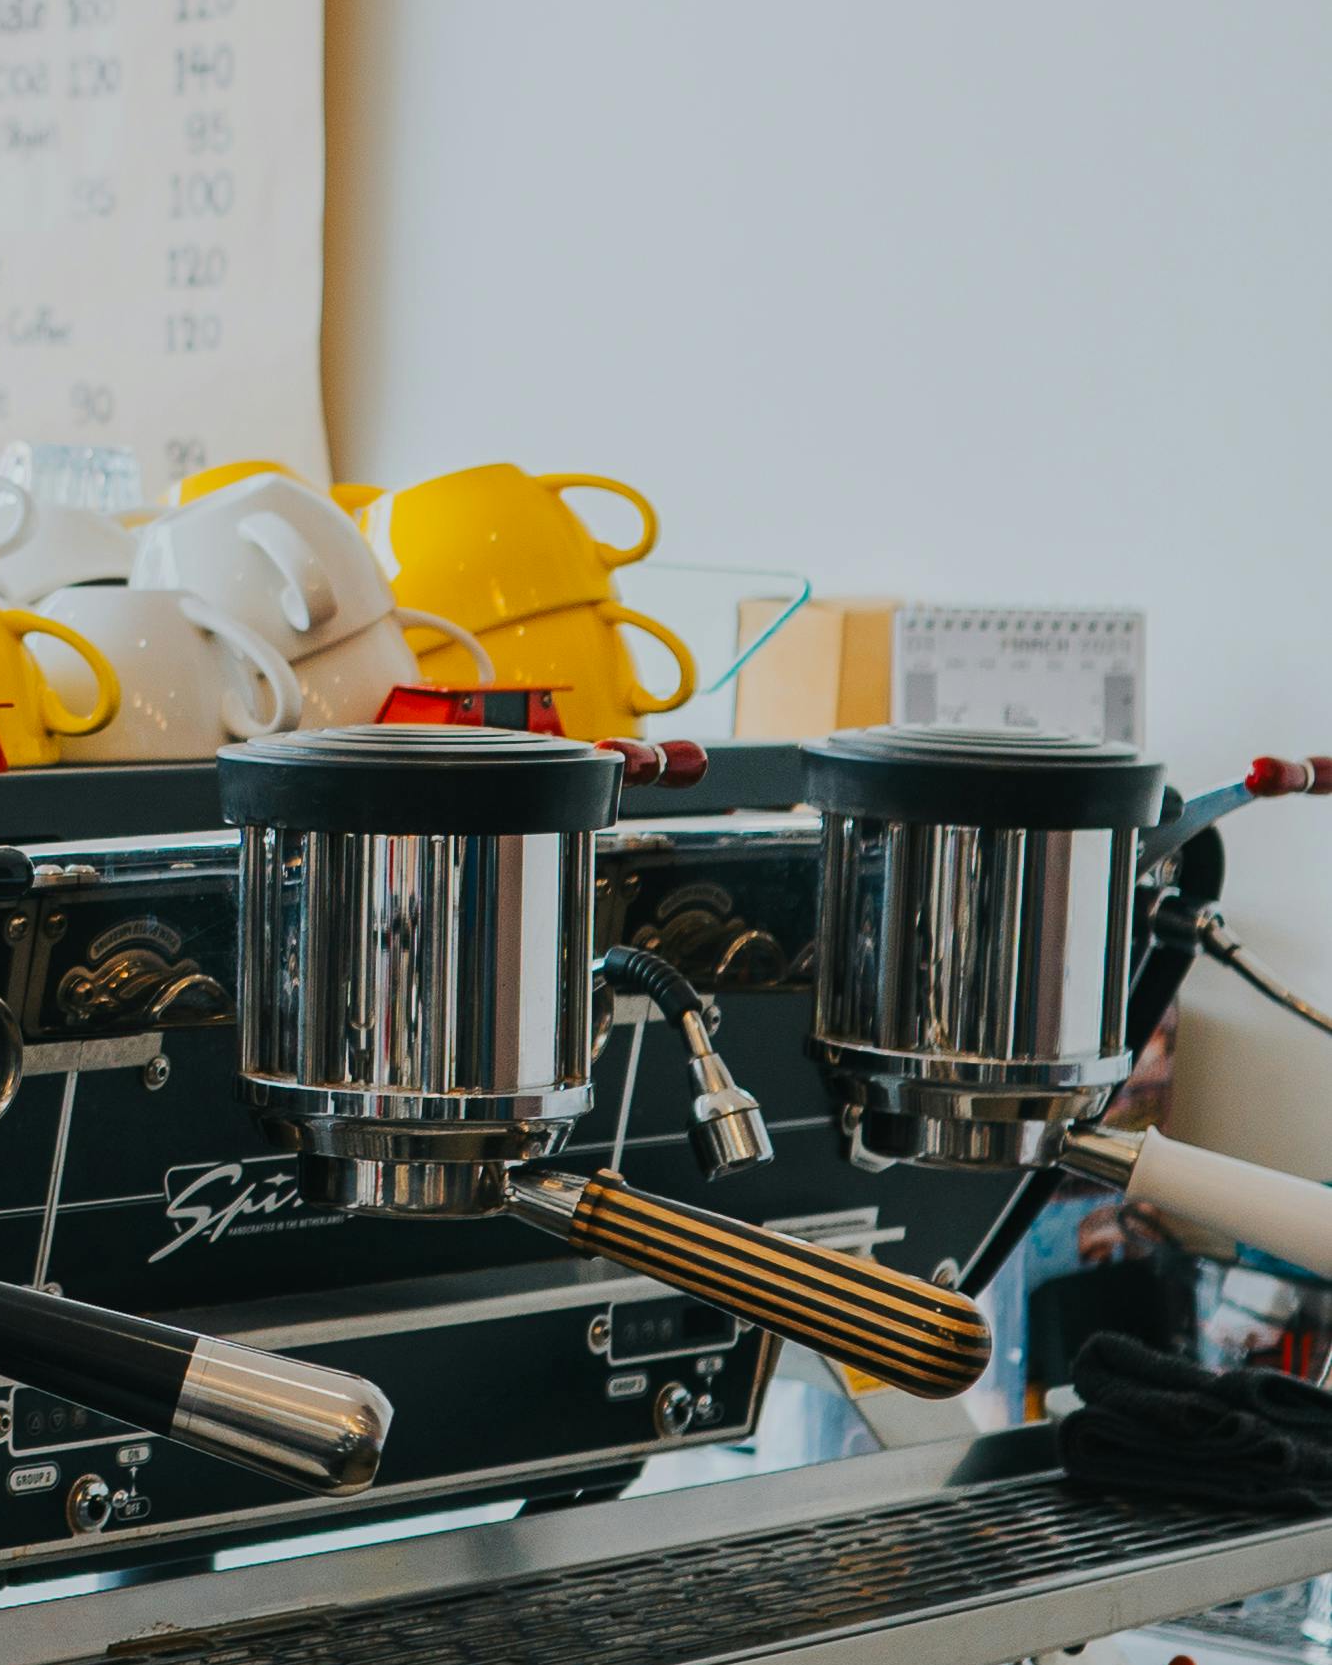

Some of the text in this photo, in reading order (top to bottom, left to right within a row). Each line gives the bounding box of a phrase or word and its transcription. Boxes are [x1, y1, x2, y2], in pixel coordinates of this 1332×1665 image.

[170, 169, 234, 218] 100
[16, 1471, 52, 1486] GROUP 2
